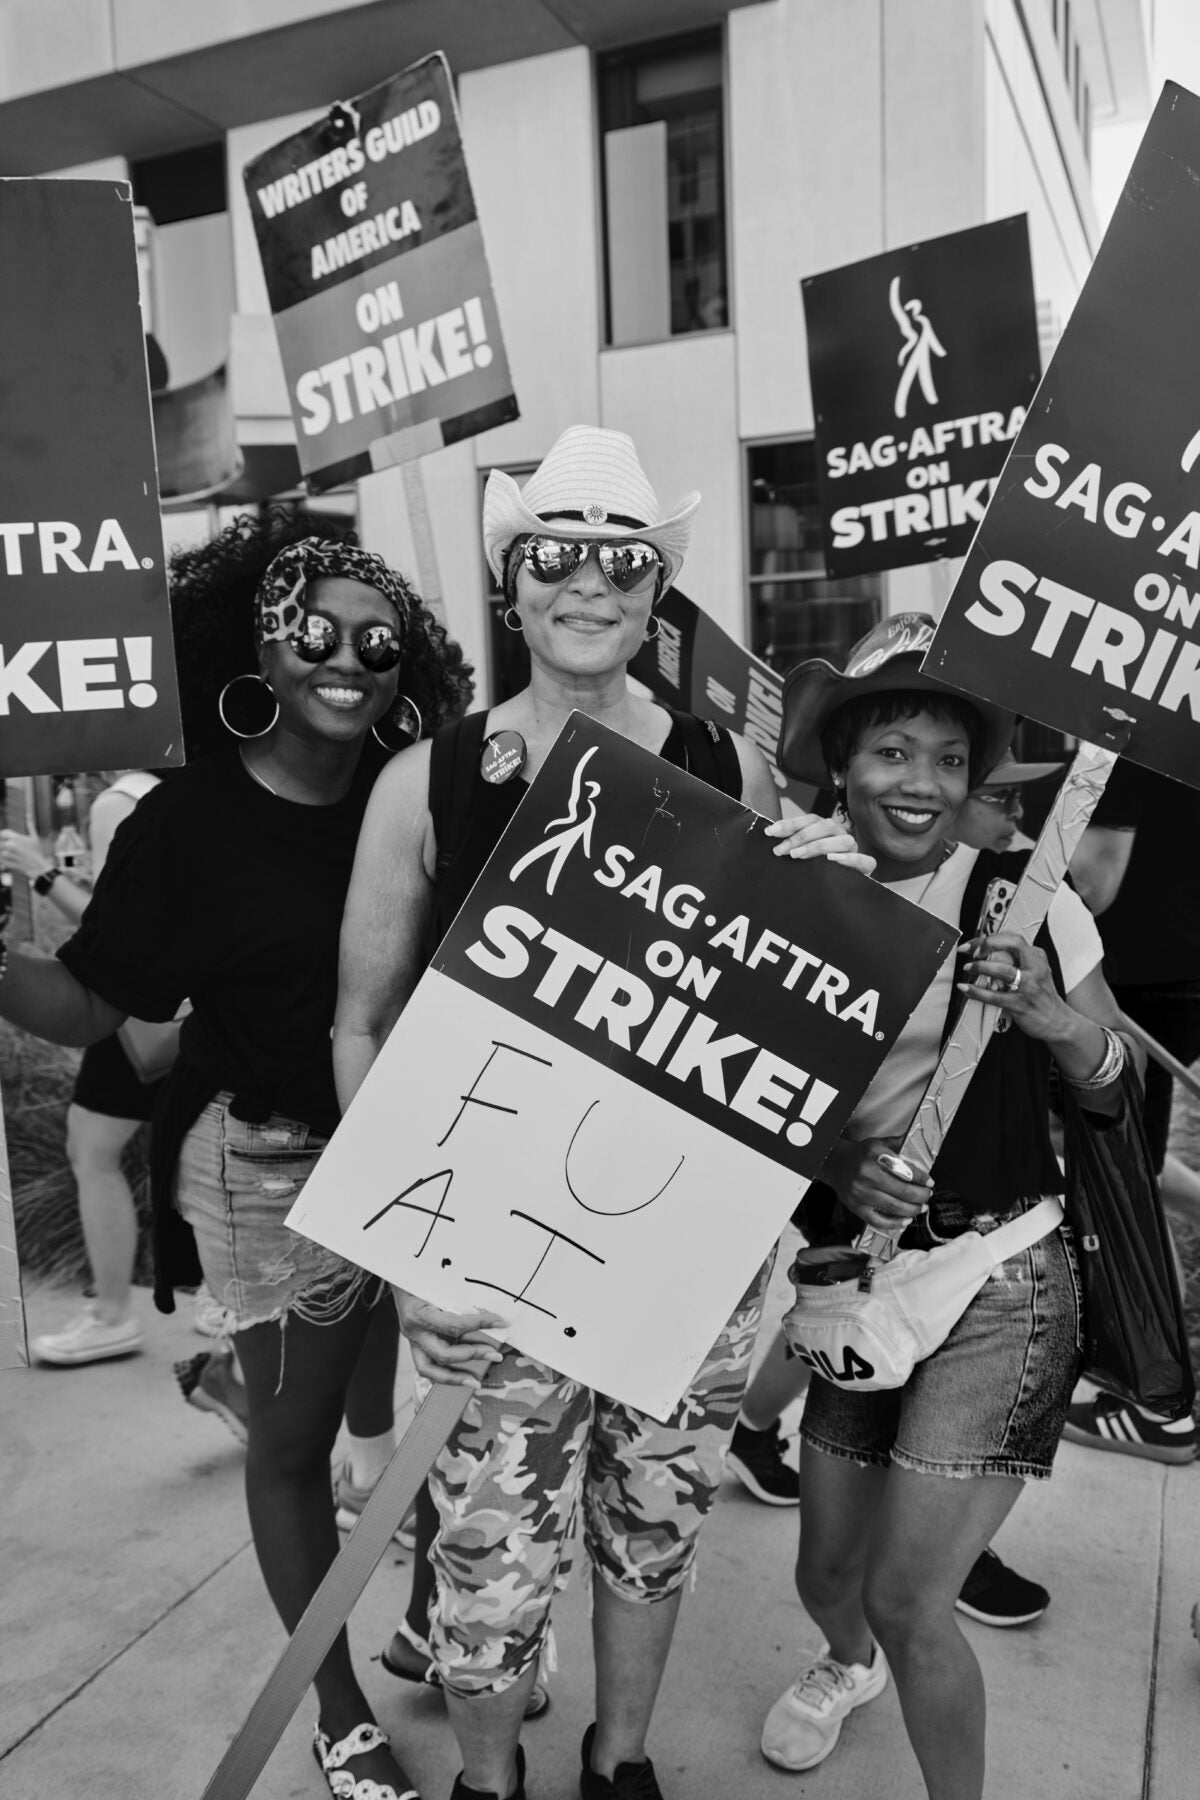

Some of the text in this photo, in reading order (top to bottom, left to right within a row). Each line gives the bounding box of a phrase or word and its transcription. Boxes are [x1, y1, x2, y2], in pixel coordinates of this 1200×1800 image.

[257, 100, 440, 219] WRITERS GUILD
[340, 181, 368, 218] OF
[311, 199, 422, 280] AMERICA
[355, 281, 404, 334] ON
[296, 296, 493, 437] STRIKE!
[906, 461, 950, 489] ON
[888, 613, 920, 640] Enjoy
[1134, 573, 1200, 629] ON
[658, 617, 682, 690] AMERICA
[706, 675, 736, 715] ON
[489, 756, 522, 783] STRIKE!
[645, 940, 722, 1002] ON
[465, 905, 839, 1147] STRIKE!
[437, 1040, 685, 1216] F U
[793, 1342, 875, 1382] FILA
